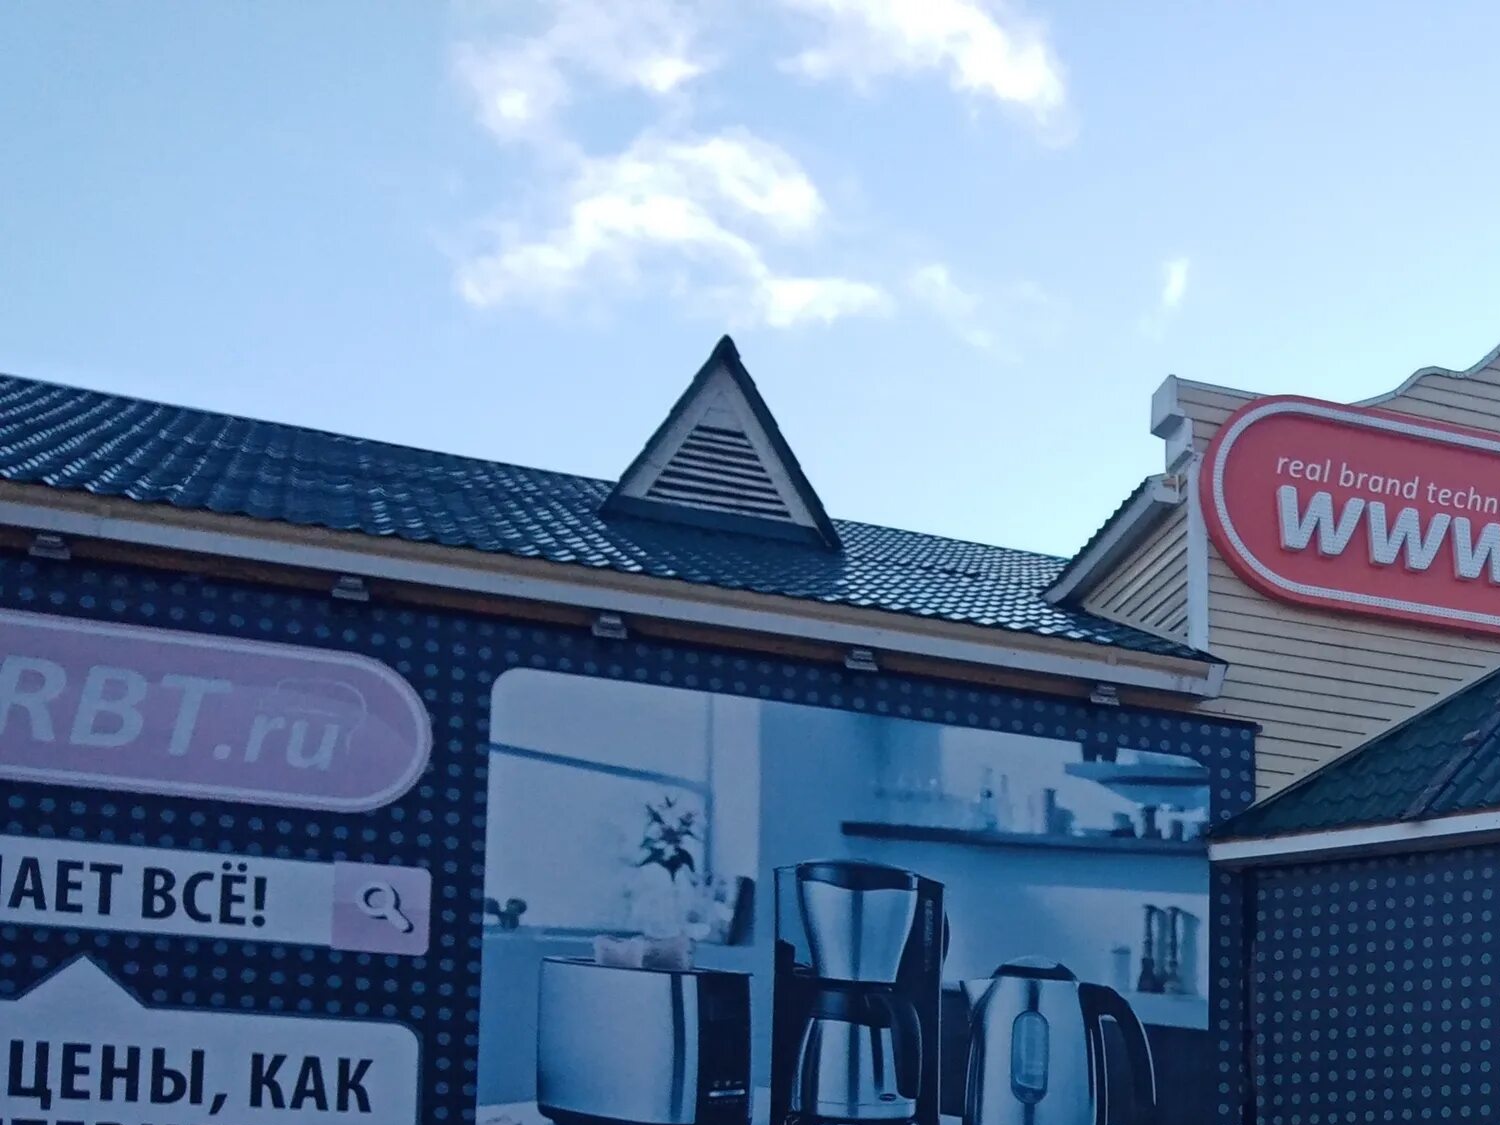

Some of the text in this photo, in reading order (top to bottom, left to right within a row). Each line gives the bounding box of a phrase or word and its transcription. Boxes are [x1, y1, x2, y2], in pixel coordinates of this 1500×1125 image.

[1276, 455, 1330, 485] real
[1339, 462, 1419, 503] brand
[0, 854, 268, 929] АЕТ ВСЁ!
[7, 1039, 374, 1115] ЦЕНЫ, КАК
